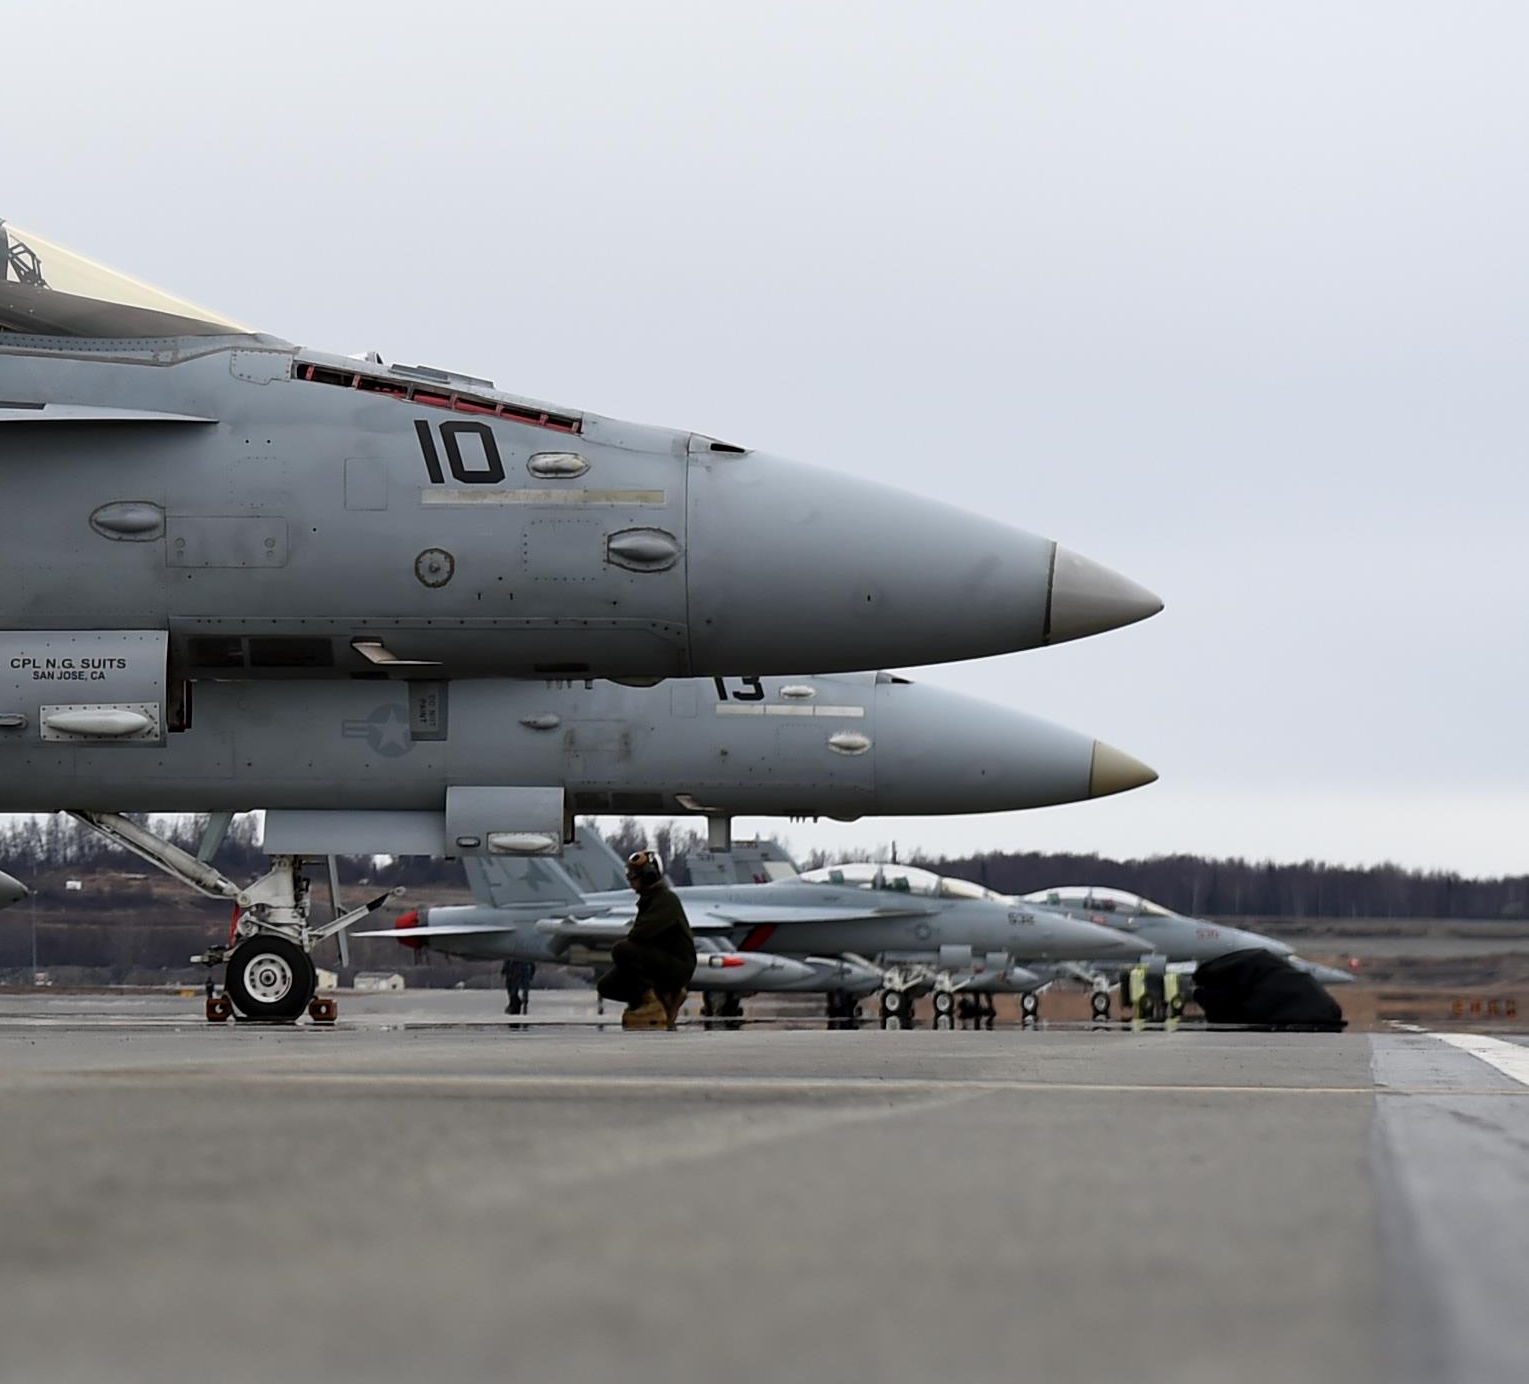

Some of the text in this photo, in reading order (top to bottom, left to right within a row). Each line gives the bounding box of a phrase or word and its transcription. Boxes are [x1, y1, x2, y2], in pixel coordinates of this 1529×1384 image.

[413, 420, 506, 484] 10
[10, 658, 127, 669] CPL N.G. SUITS
[32, 670, 106, 682] SAN JOSE, CA
